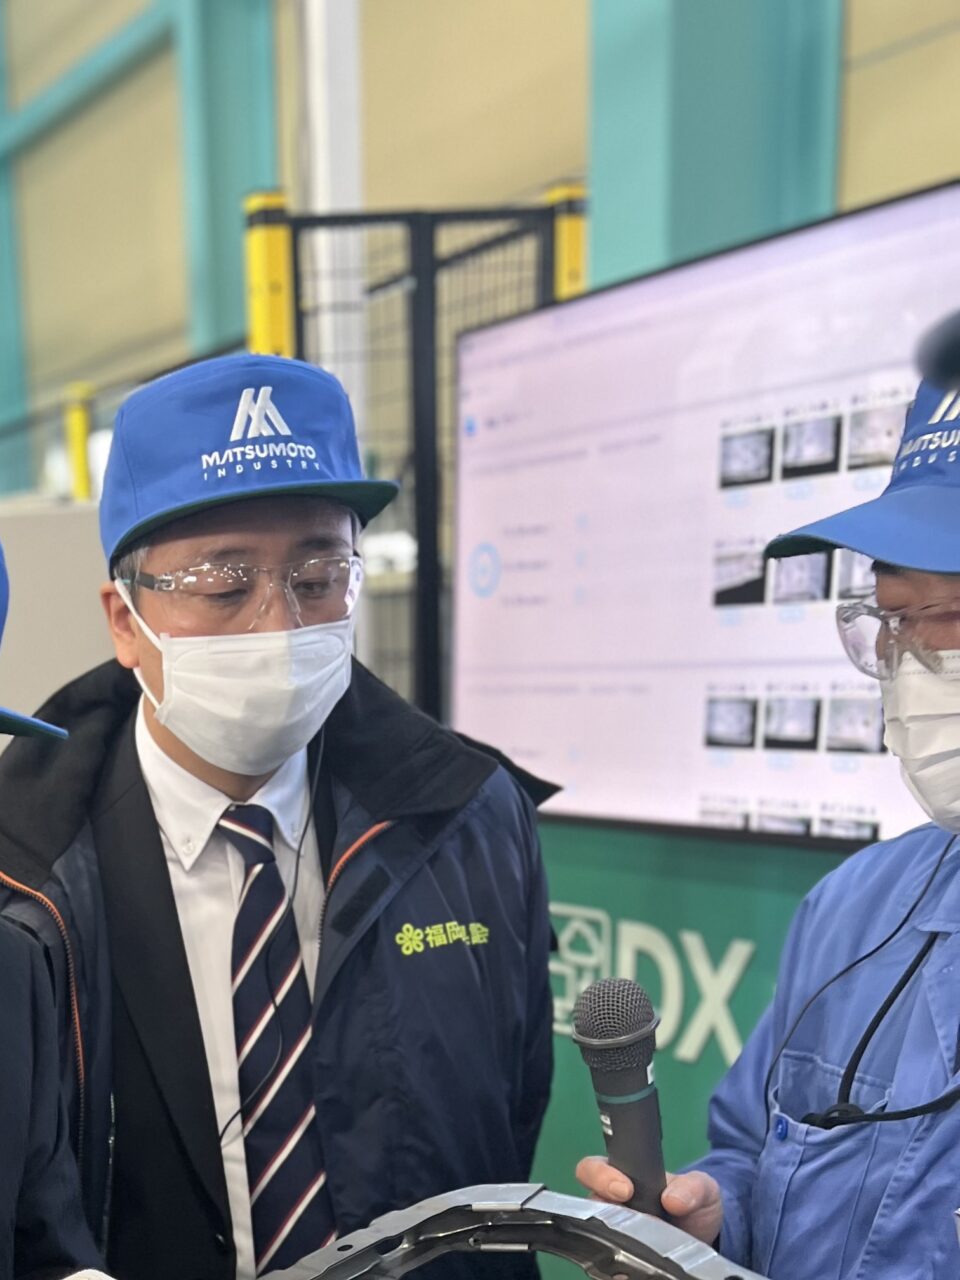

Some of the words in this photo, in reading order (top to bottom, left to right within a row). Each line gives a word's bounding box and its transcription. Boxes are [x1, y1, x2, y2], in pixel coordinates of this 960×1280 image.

[201, 442, 317, 469] MATSUMOTO
[203, 459, 320, 480] INDUSTRY
[616, 919, 756, 1068] DX
